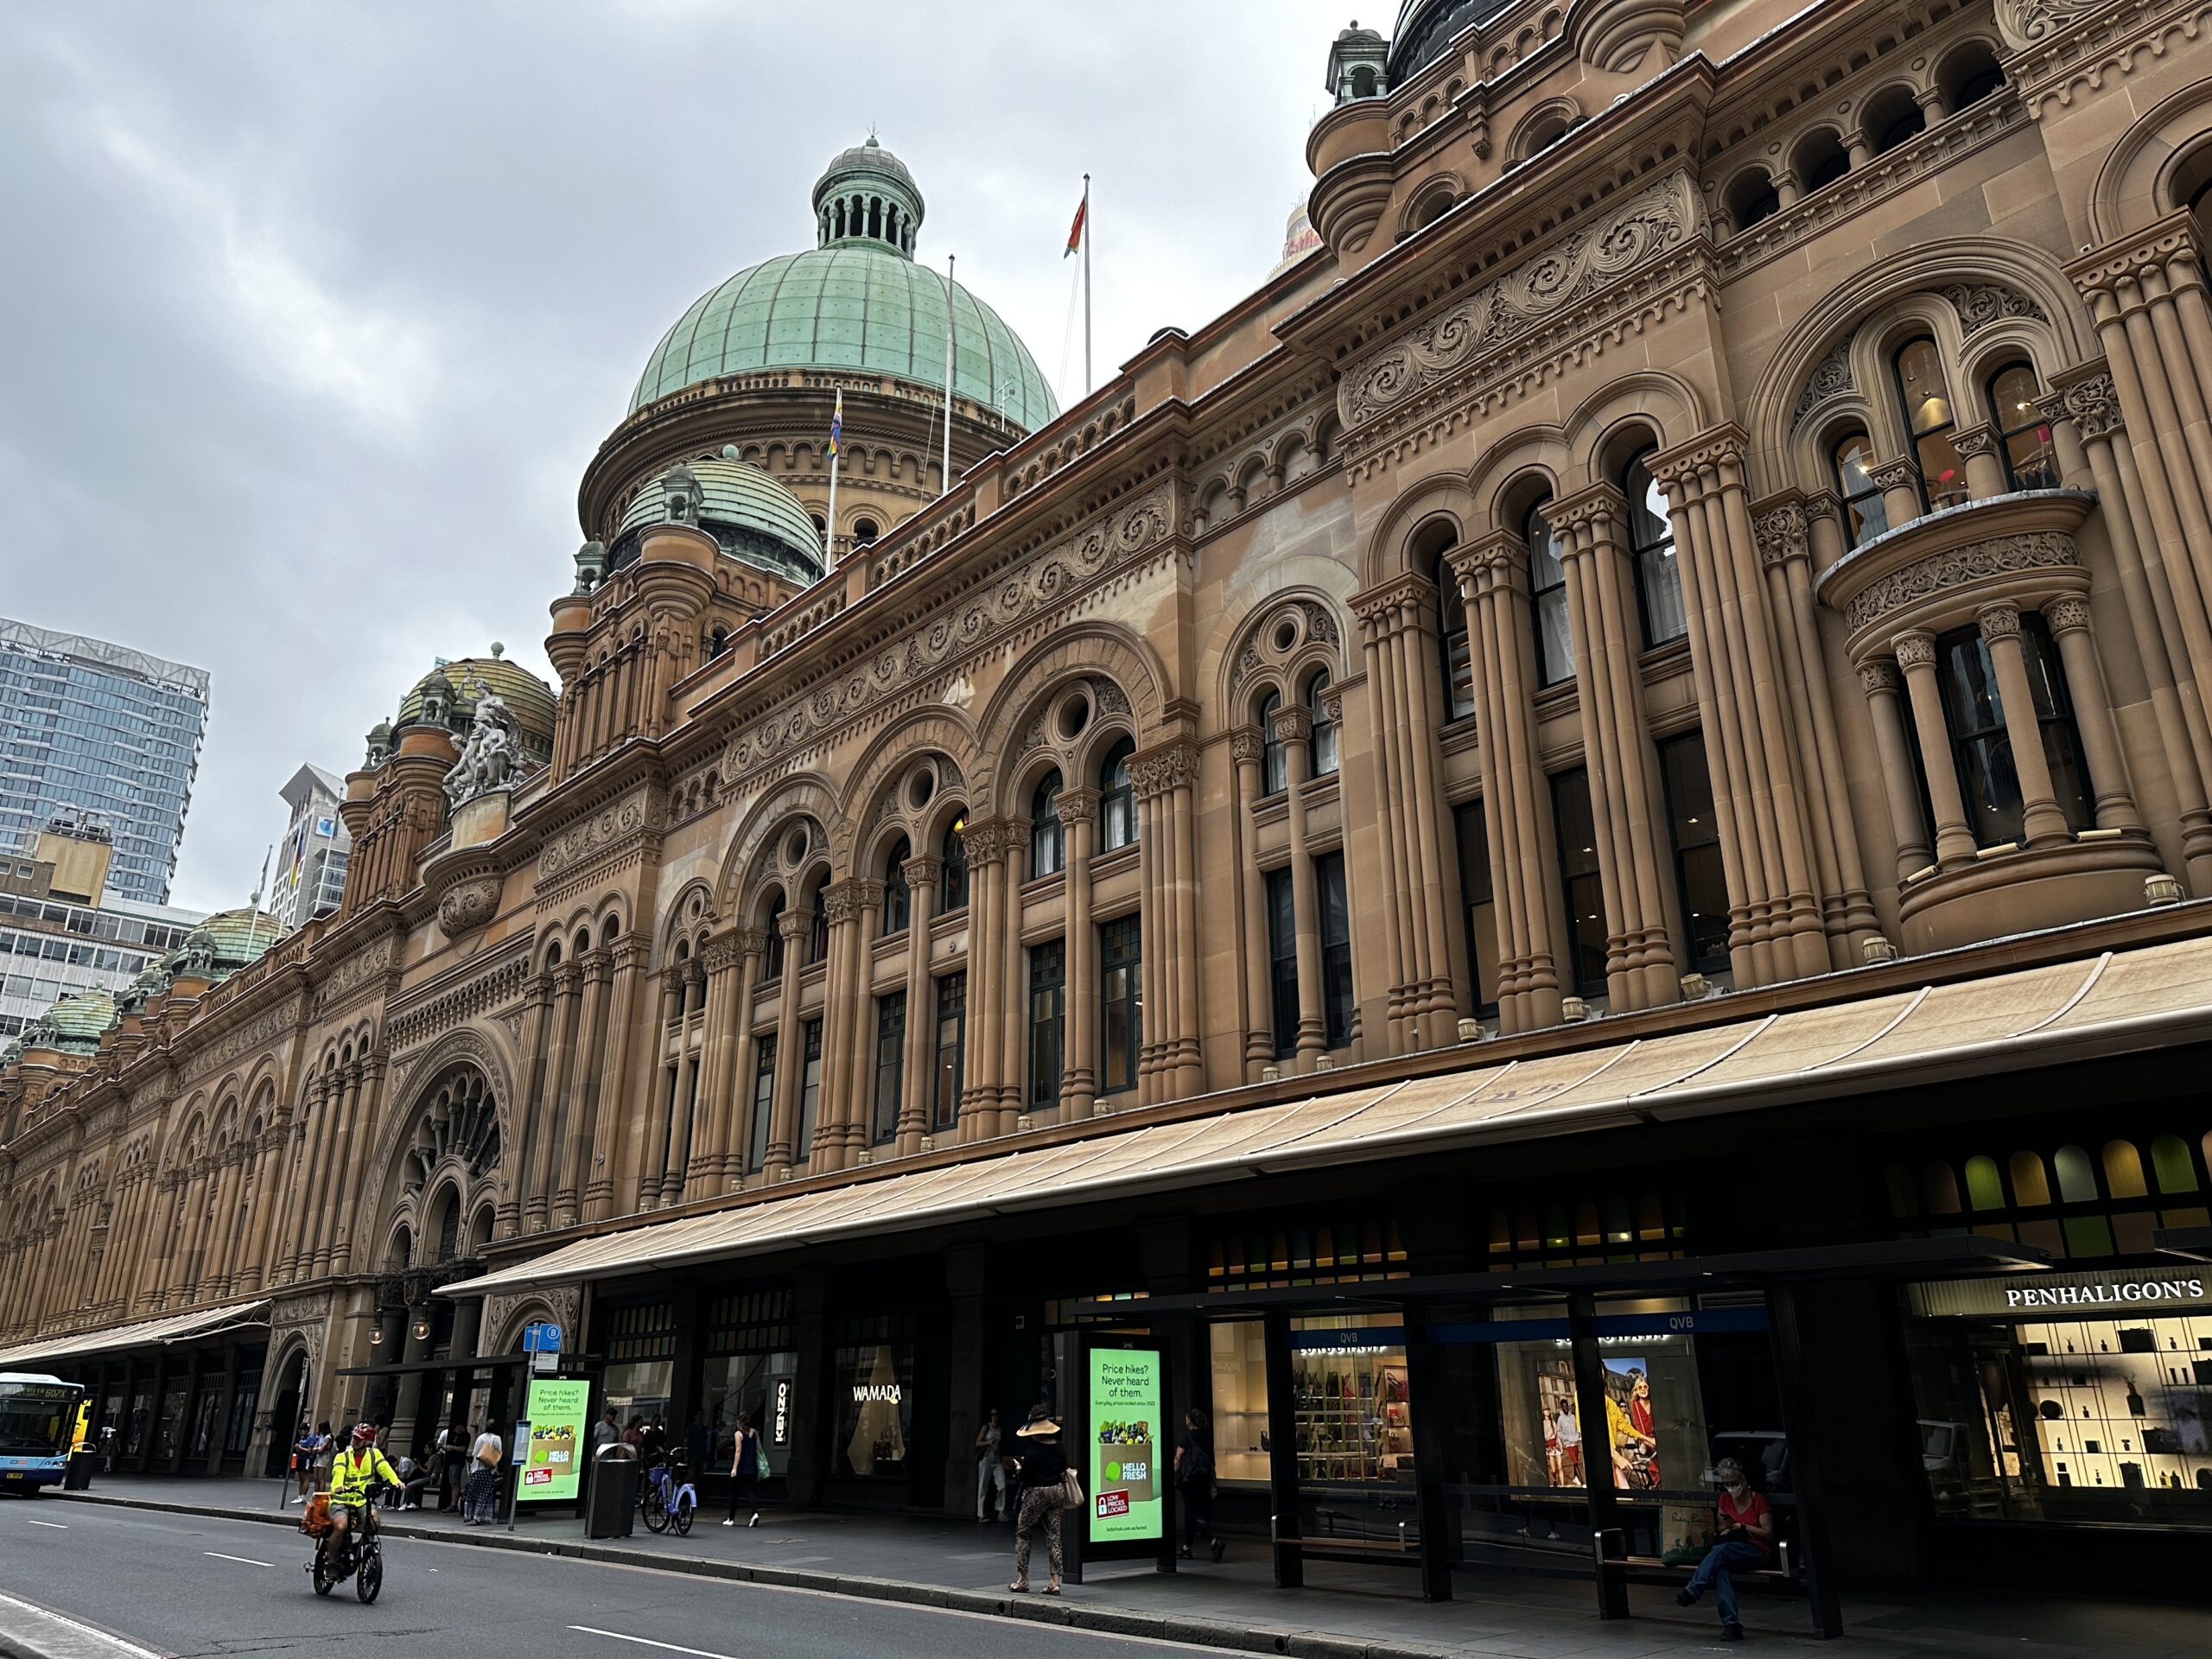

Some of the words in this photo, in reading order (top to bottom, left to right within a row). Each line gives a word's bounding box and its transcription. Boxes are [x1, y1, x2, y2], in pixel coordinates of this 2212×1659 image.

[2005, 1279, 2203, 1306] PENHALIGON'S
[1670, 1316, 1694, 1331] QVB
[1340, 1332, 1357, 1344] QVB
[1103, 1363, 1123, 1373] Price
[1126, 1364, 1148, 1374] hikes?
[1102, 1376, 1124, 1385] Never
[1127, 1376, 1149, 1386] heard
[45, 1389, 67, 1398] 607X
[853, 1384, 901, 1402] WAMADA
[1109, 1387, 1118, 1396] of
[1121, 1388, 1142, 1397] them.
[775, 1382, 786, 1441] KENZO
[1122, 1462, 1147, 1471] HELLO
[1122, 1471, 1147, 1480] FRESH
[1108, 1505, 1128, 1514] LOCKED
